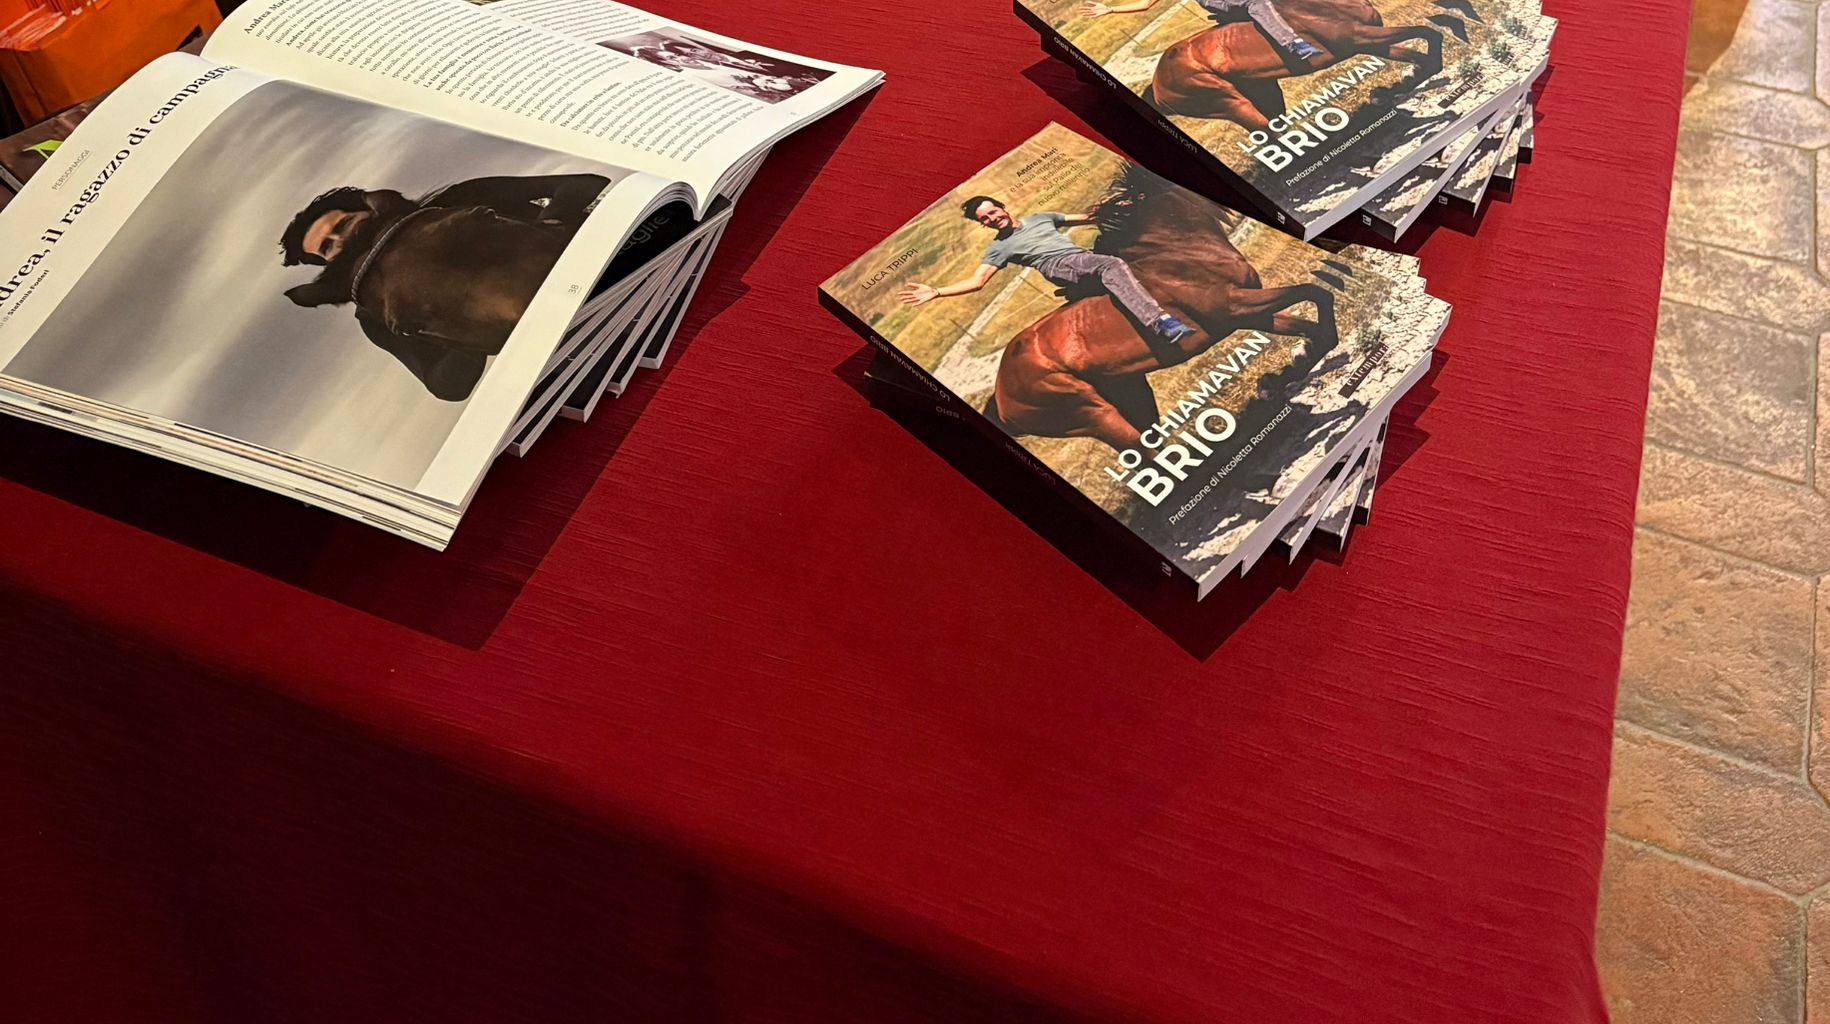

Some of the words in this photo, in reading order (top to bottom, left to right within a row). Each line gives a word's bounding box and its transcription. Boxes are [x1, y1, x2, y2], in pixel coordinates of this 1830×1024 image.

[243, 10, 271, 34] Andrea
[285, 28, 306, 46] Andrea,
[1053, 36, 1069, 52] BRIO
[1070, 49, 1107, 81] CHIAMAVAN
[1107, 79, 1117, 89] LO
[1236, 130, 1268, 154] LO
[1268, 55, 1386, 132] CHIAMAVAN
[1254, 106, 1350, 173] BRIO
[1286, 159, 1323, 187] Prefazione
[1323, 153, 1330, 163] di
[1329, 132, 1361, 158] Nicoletta
[1359, 108, 1397, 137] Romanazzi
[51, 150, 91, 191] PERSONAGGI
[1016, 157, 1042, 178] Andrea
[1041, 146, 1059, 164] Mari
[0, 249, 50, 308] drea,
[41, 229, 65, 244] il
[60, 148, 131, 225] ragazzo
[127, 127, 152, 146] di
[1037, 188, 1061, 207] nuovo
[568, 284, 579, 294] 38
[862, 269, 888, 290] LUCA
[887, 248, 917, 273] TRIPPI
[889, 349, 940, 392] CHIAMAVAN
[938, 388, 951, 402] LO
[1104, 448, 1142, 482] LO
[1140, 330, 1272, 449] CHIAMAVAN
[1126, 407, 1236, 507] BRIO
[1168, 484, 1211, 526] Prefazione
[1210, 476, 1219, 487] di
[1217, 444, 1252, 479] Nicoletta
[1250, 404, 1292, 447] Romanazzi
